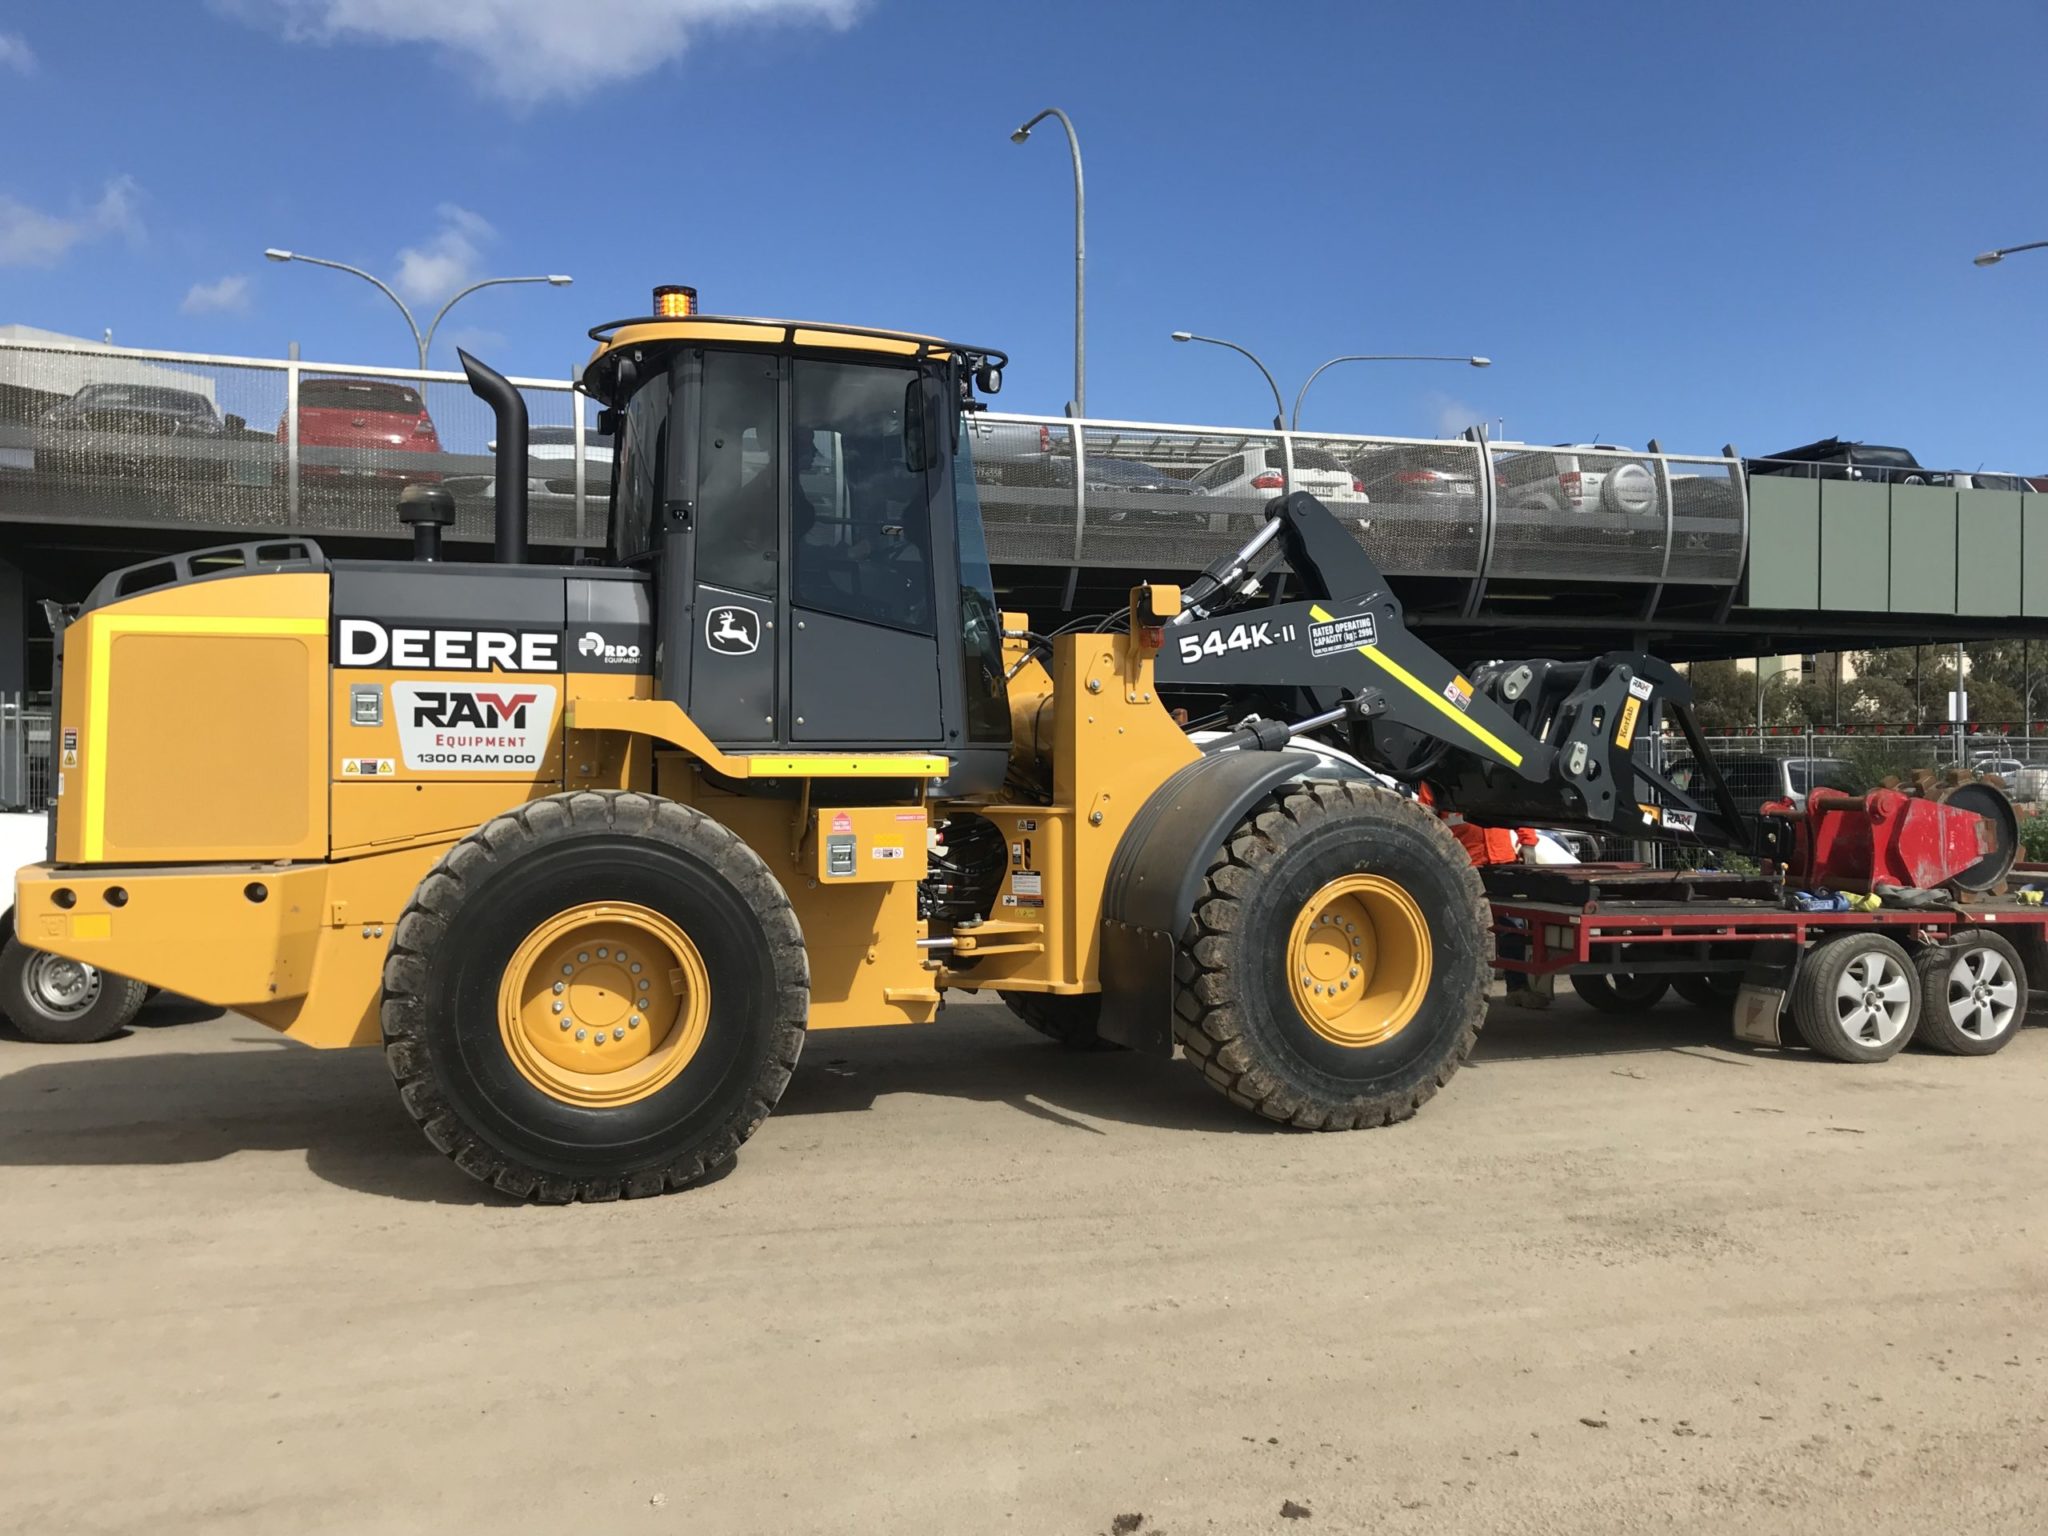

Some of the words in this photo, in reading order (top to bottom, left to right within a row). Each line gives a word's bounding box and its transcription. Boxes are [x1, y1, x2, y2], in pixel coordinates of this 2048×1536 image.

[1312, 625, 1334, 638] RATED
[1334, 618, 1371, 633] OPERATING
[339, 619, 558, 671] DEERE
[1314, 633, 1342, 647] CAPACITY
[604, 656, 641, 664] EQUIPMENT
[413, 691, 537, 729] RAM
[435, 734, 526, 747] EQUIPMENT
[417, 754, 457, 763] 1300
[461, 754, 499, 763] RAM
[503, 754, 535, 764] 000
[1666, 811, 1693, 825] RAM
